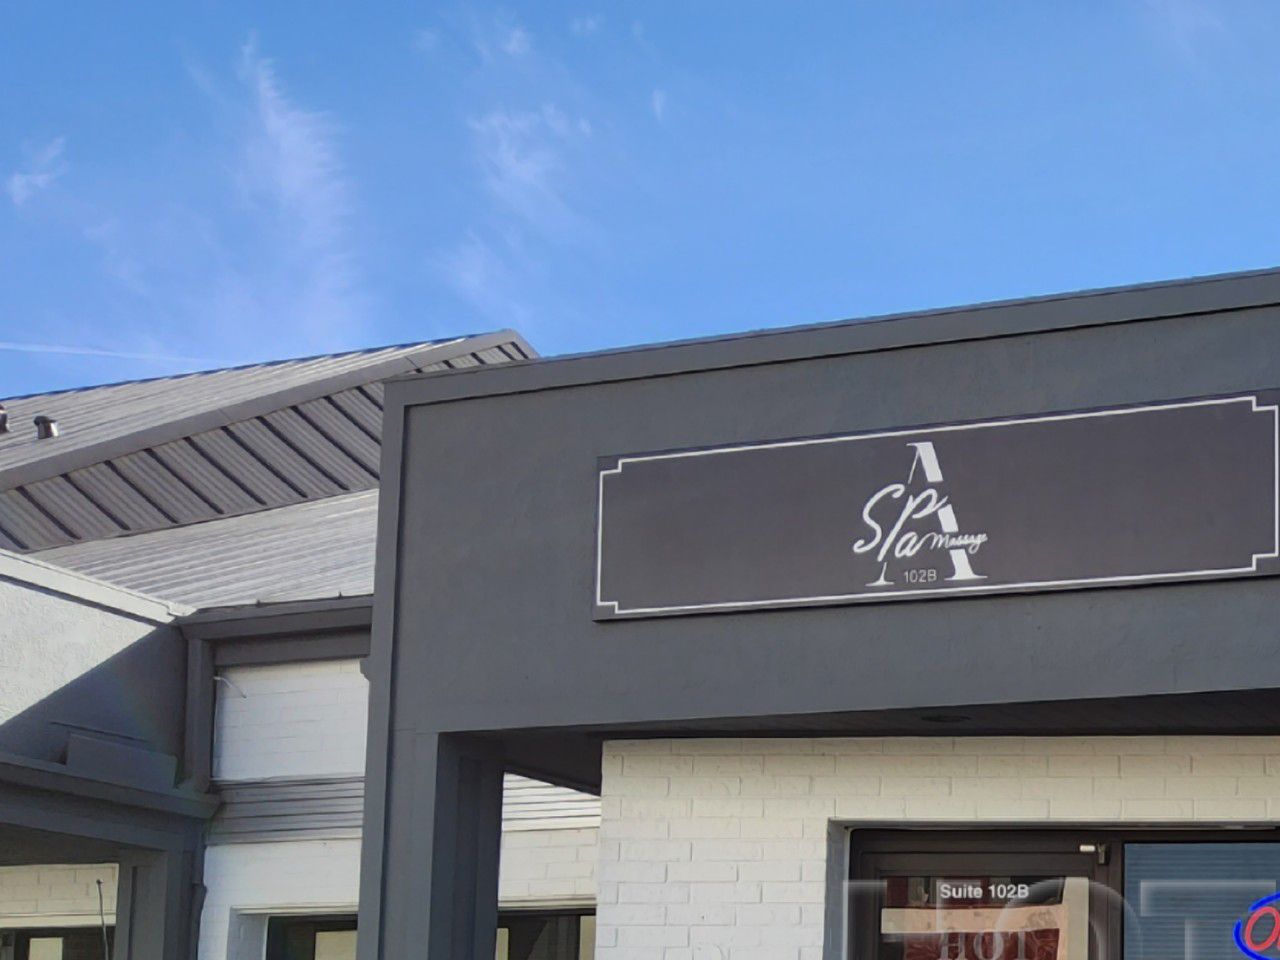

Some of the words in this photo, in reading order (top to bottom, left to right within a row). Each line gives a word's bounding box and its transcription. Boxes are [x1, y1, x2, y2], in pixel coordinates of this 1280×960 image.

[904, 569, 937, 583] 102B
[940, 884, 983, 899] Suite
[989, 884, 1030, 898] 102B
